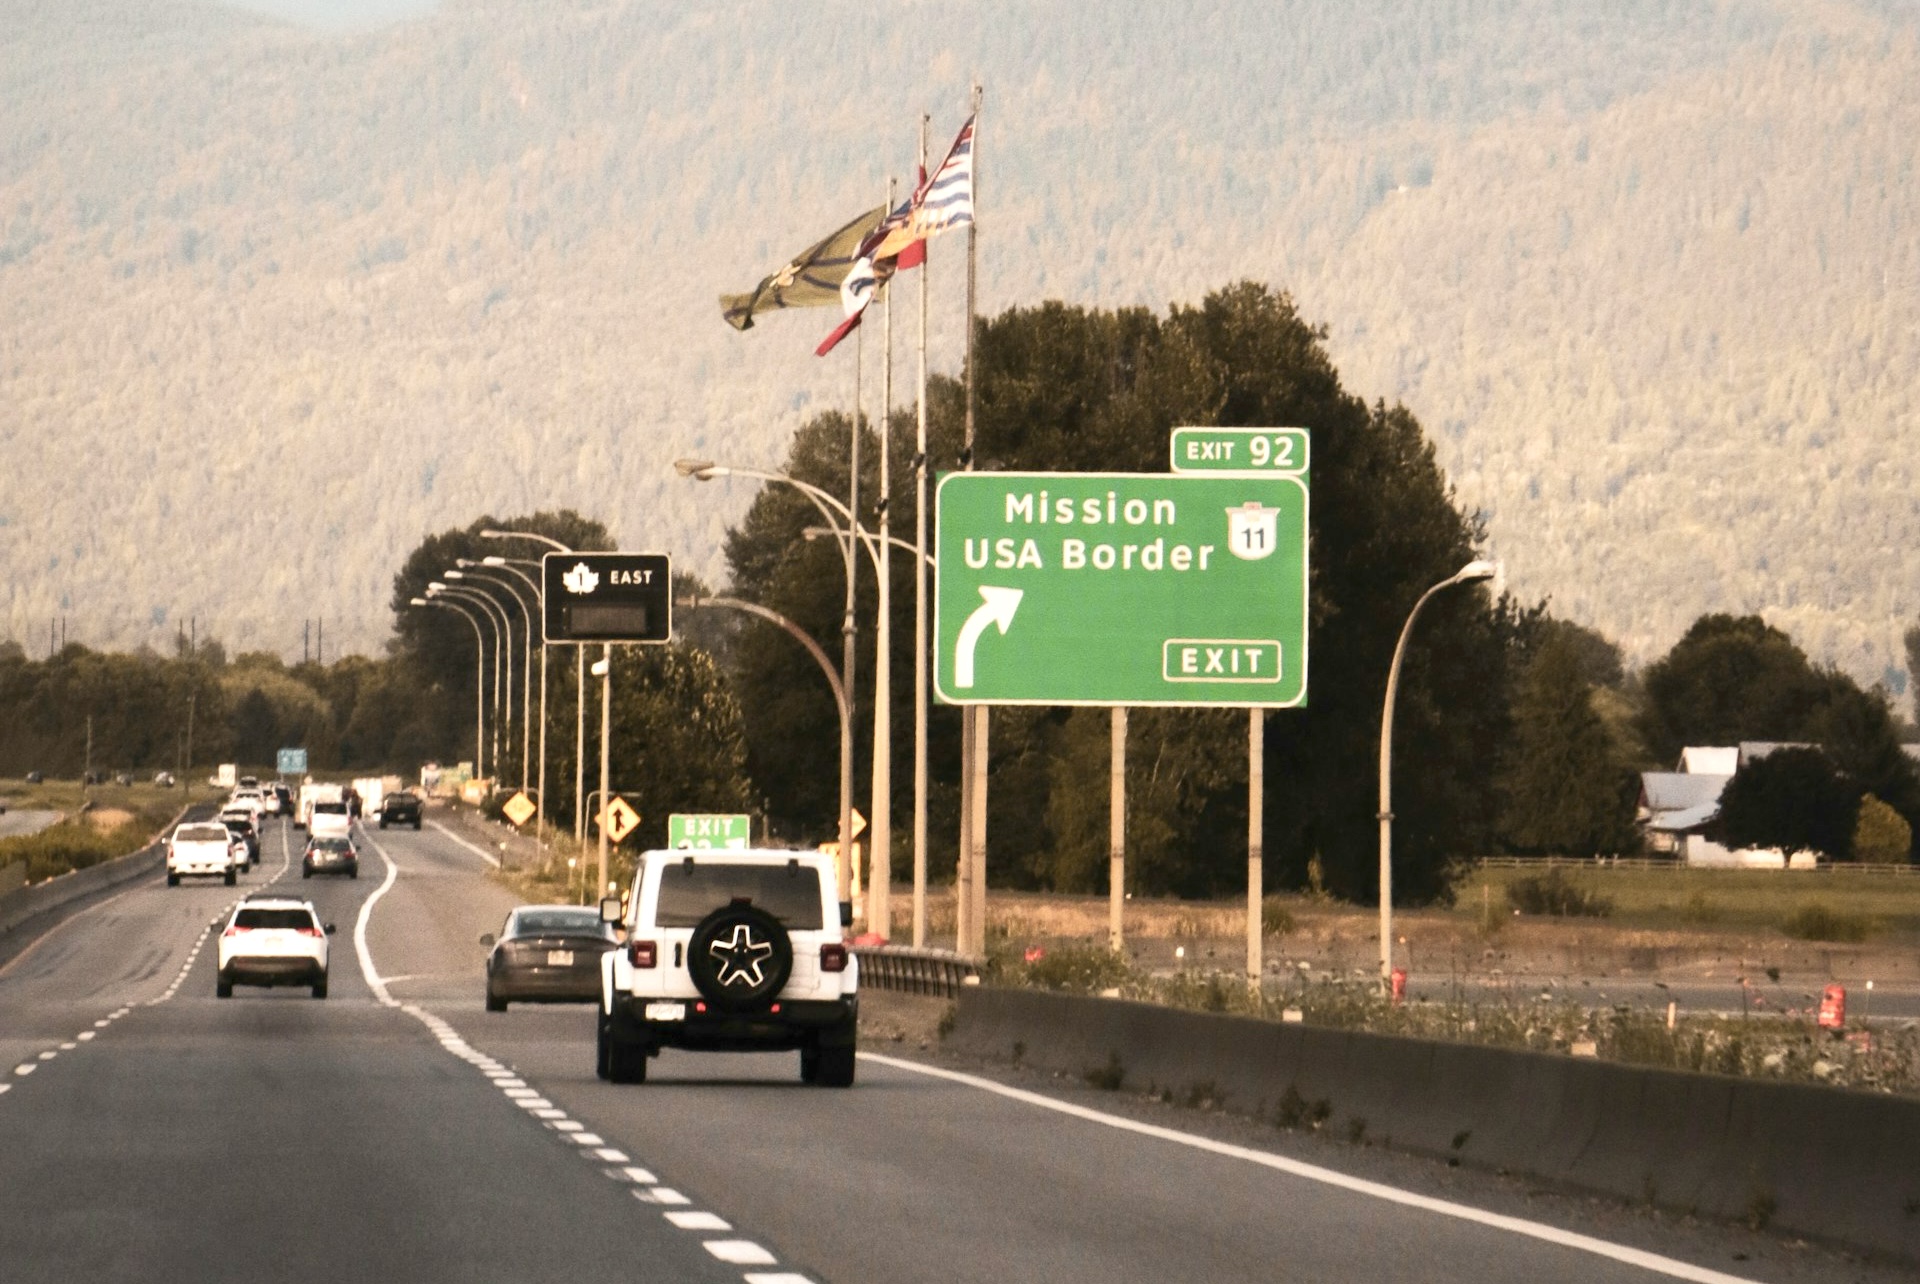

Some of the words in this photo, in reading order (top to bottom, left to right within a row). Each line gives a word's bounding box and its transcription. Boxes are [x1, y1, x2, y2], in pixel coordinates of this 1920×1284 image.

[1187, 441, 1235, 460] EXIT
[1249, 435, 1294, 467] 92
[1005, 491, 1176, 525] Mission
[1241, 527, 1265, 549] 11
[964, 538, 1043, 570] USA
[1062, 538, 1214, 571] Border
[610, 570, 653, 585] EAST
[1181, 648, 1263, 674] EXIT
[685, 818, 733, 836] EXIT
